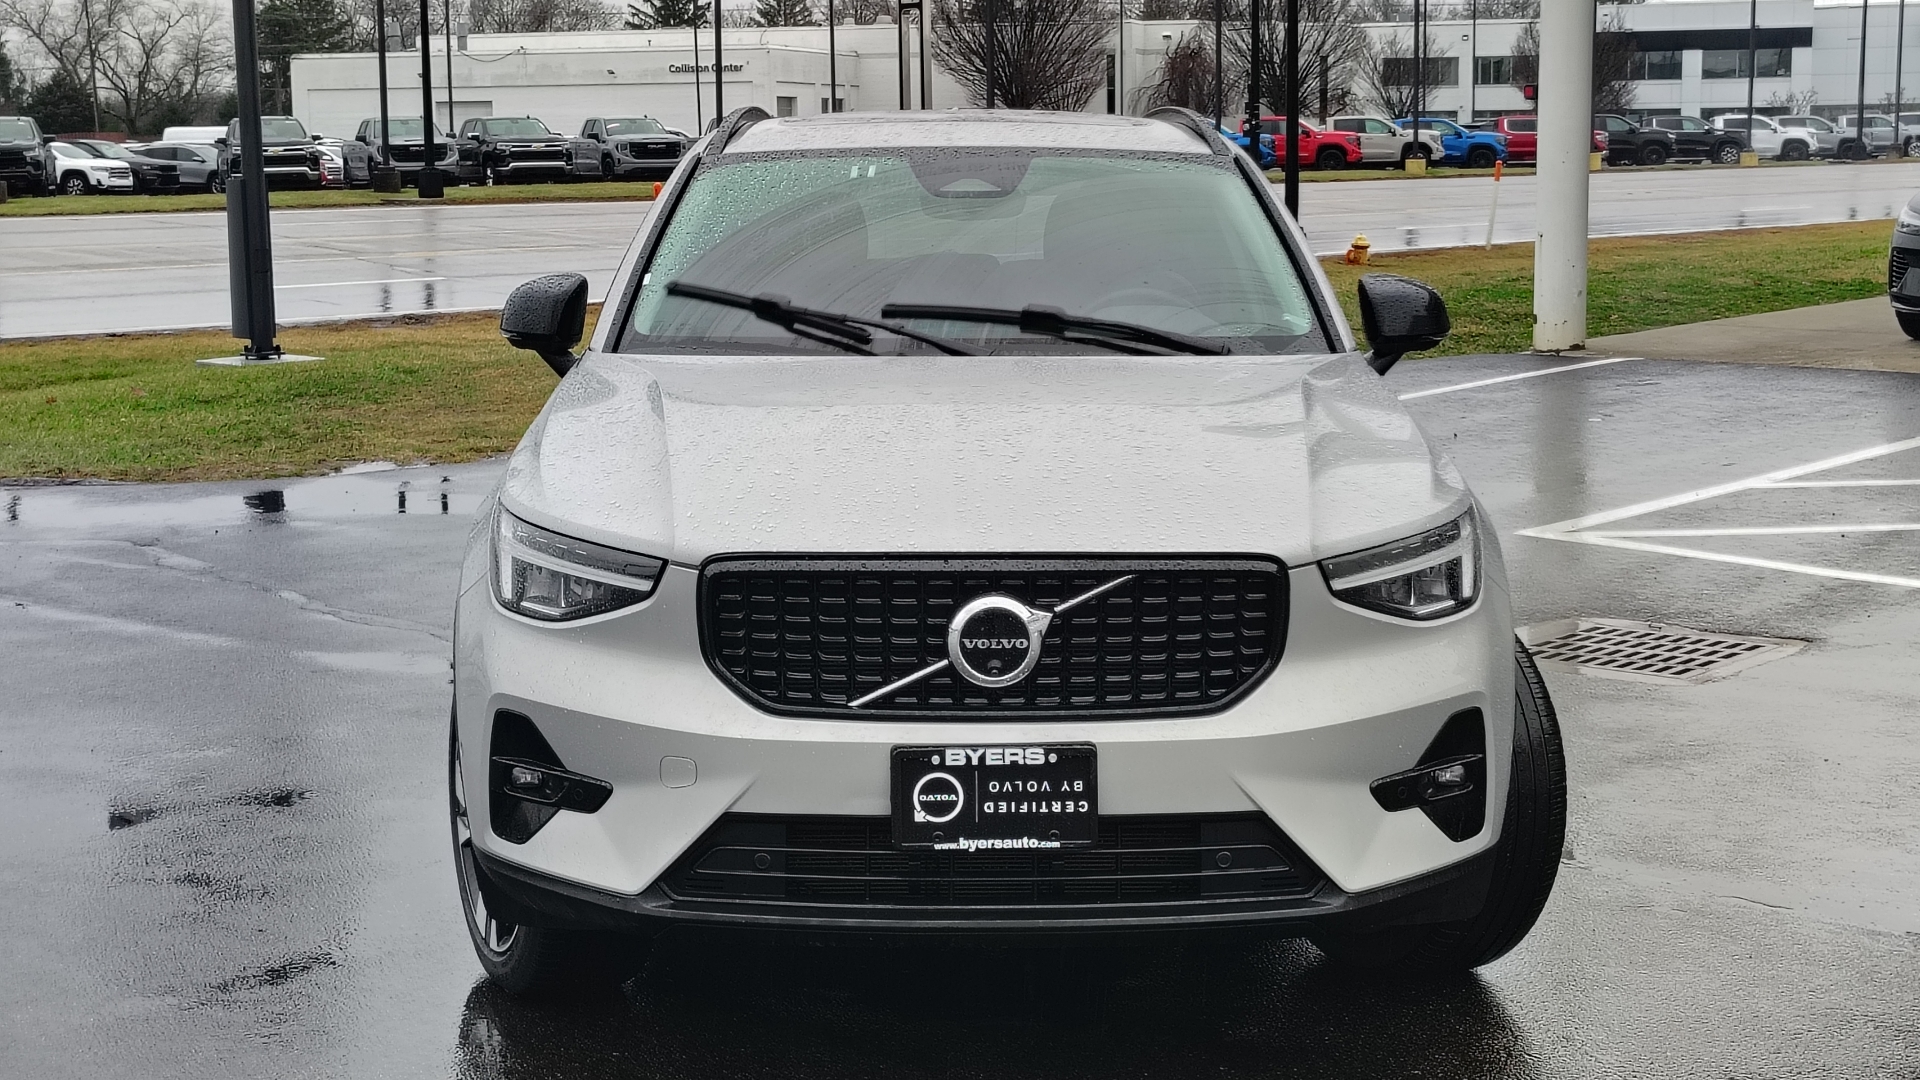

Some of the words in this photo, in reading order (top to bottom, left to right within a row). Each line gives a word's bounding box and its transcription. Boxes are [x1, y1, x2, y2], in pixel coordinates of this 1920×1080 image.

[668, 63, 709, 73] Collison
[711, 63, 743, 72] Cnter
[962, 639, 1029, 649] VOLVO
[945, 748, 1046, 766] BYERS
[989, 780, 1052, 793] VOLVO
[1061, 780, 1083, 792] BY
[983, 800, 1089, 813] CERTIFIED
[933, 836, 1061, 852] www.byersauto.com
